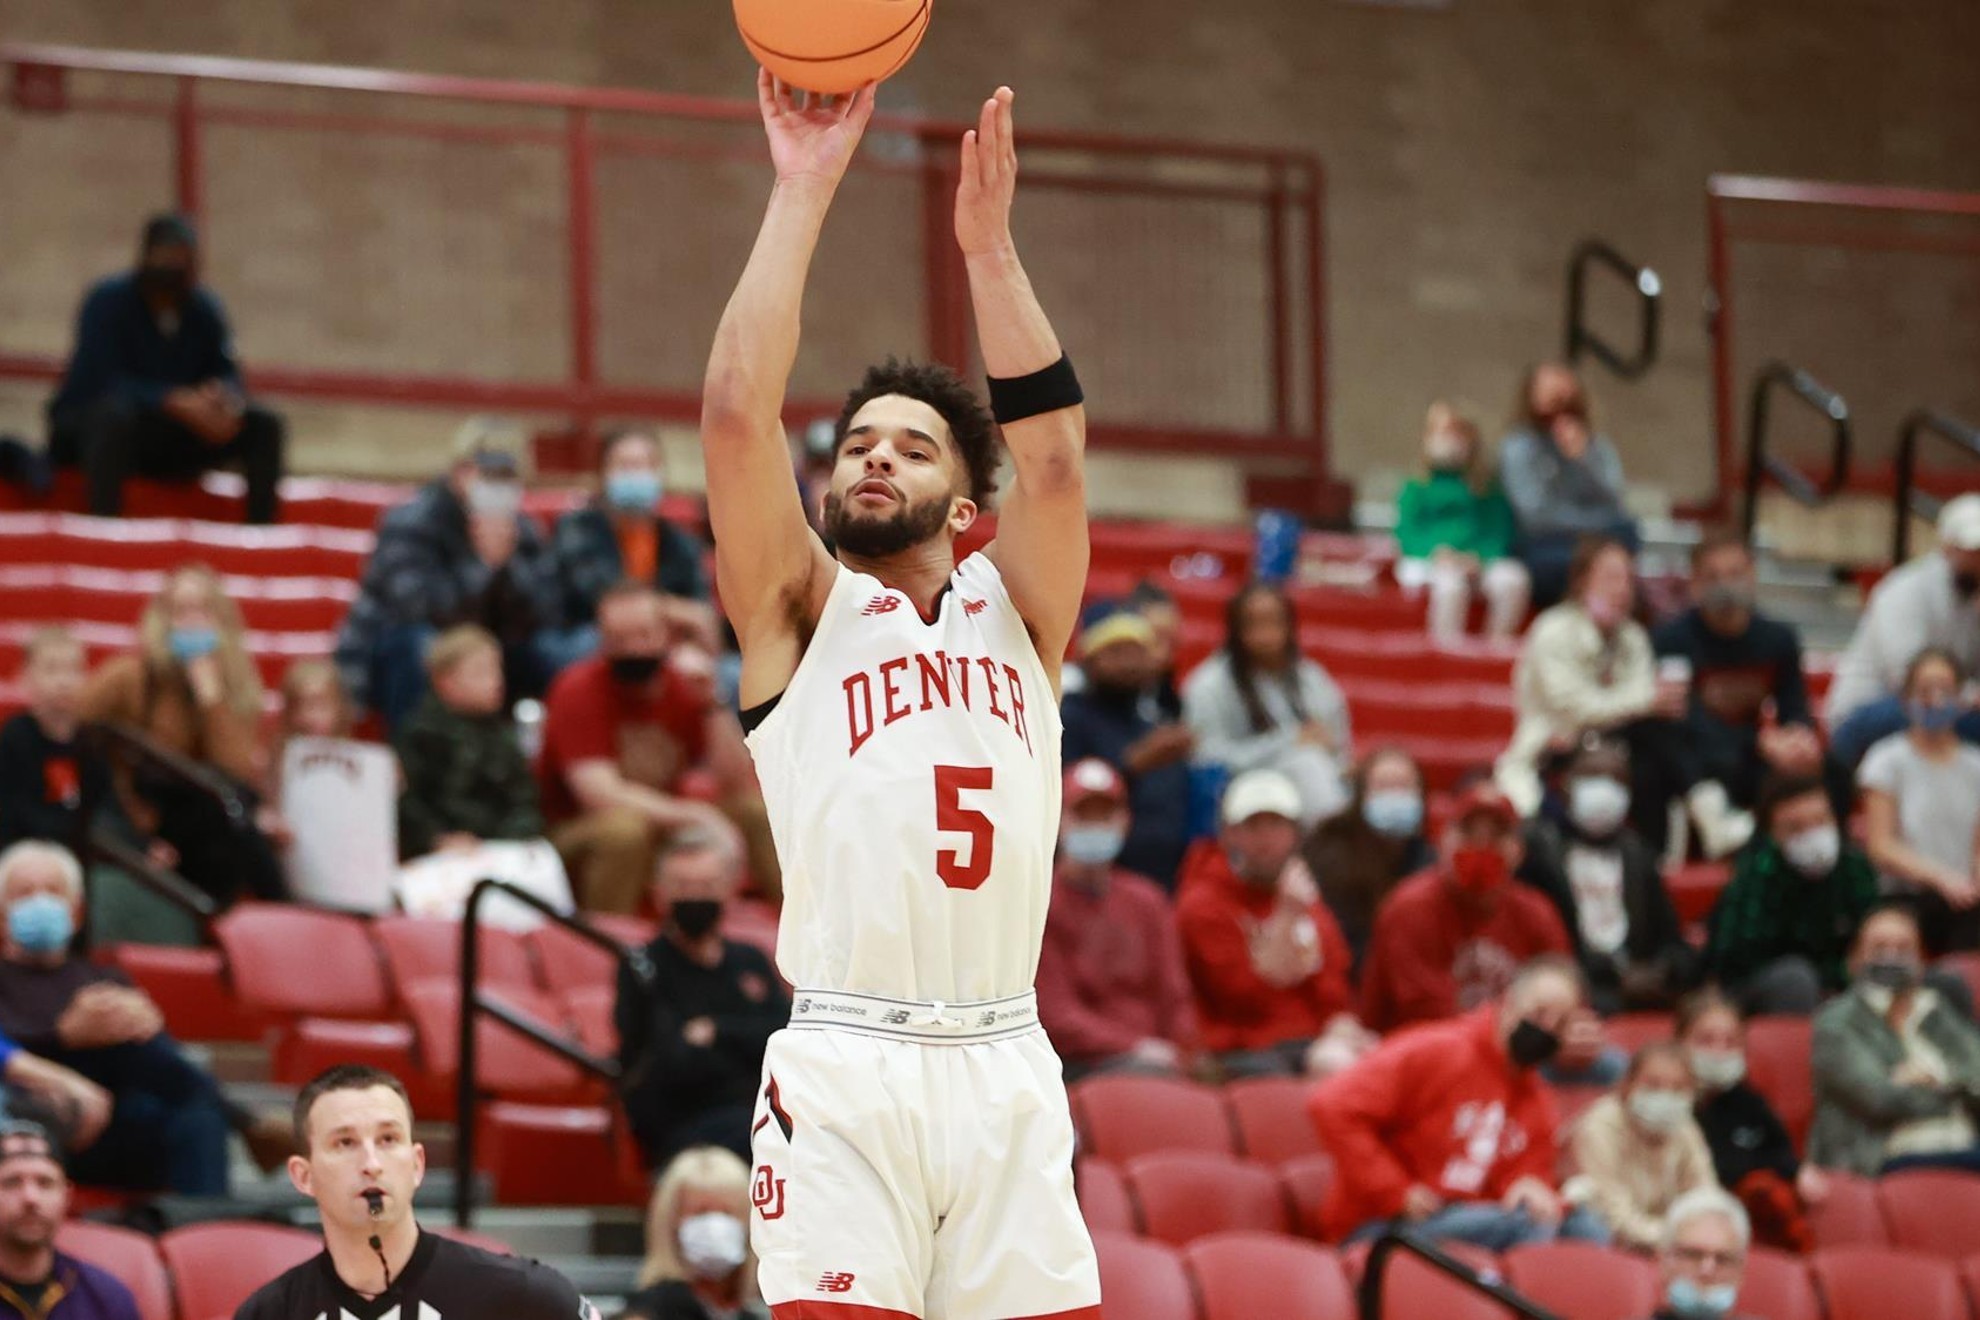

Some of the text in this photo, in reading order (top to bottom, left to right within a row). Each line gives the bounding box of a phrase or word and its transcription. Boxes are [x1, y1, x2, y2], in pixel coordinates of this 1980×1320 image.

[934, 765, 994, 890] 5
[812, 1003, 828, 1011] new
[830, 1004, 867, 1015] balance
